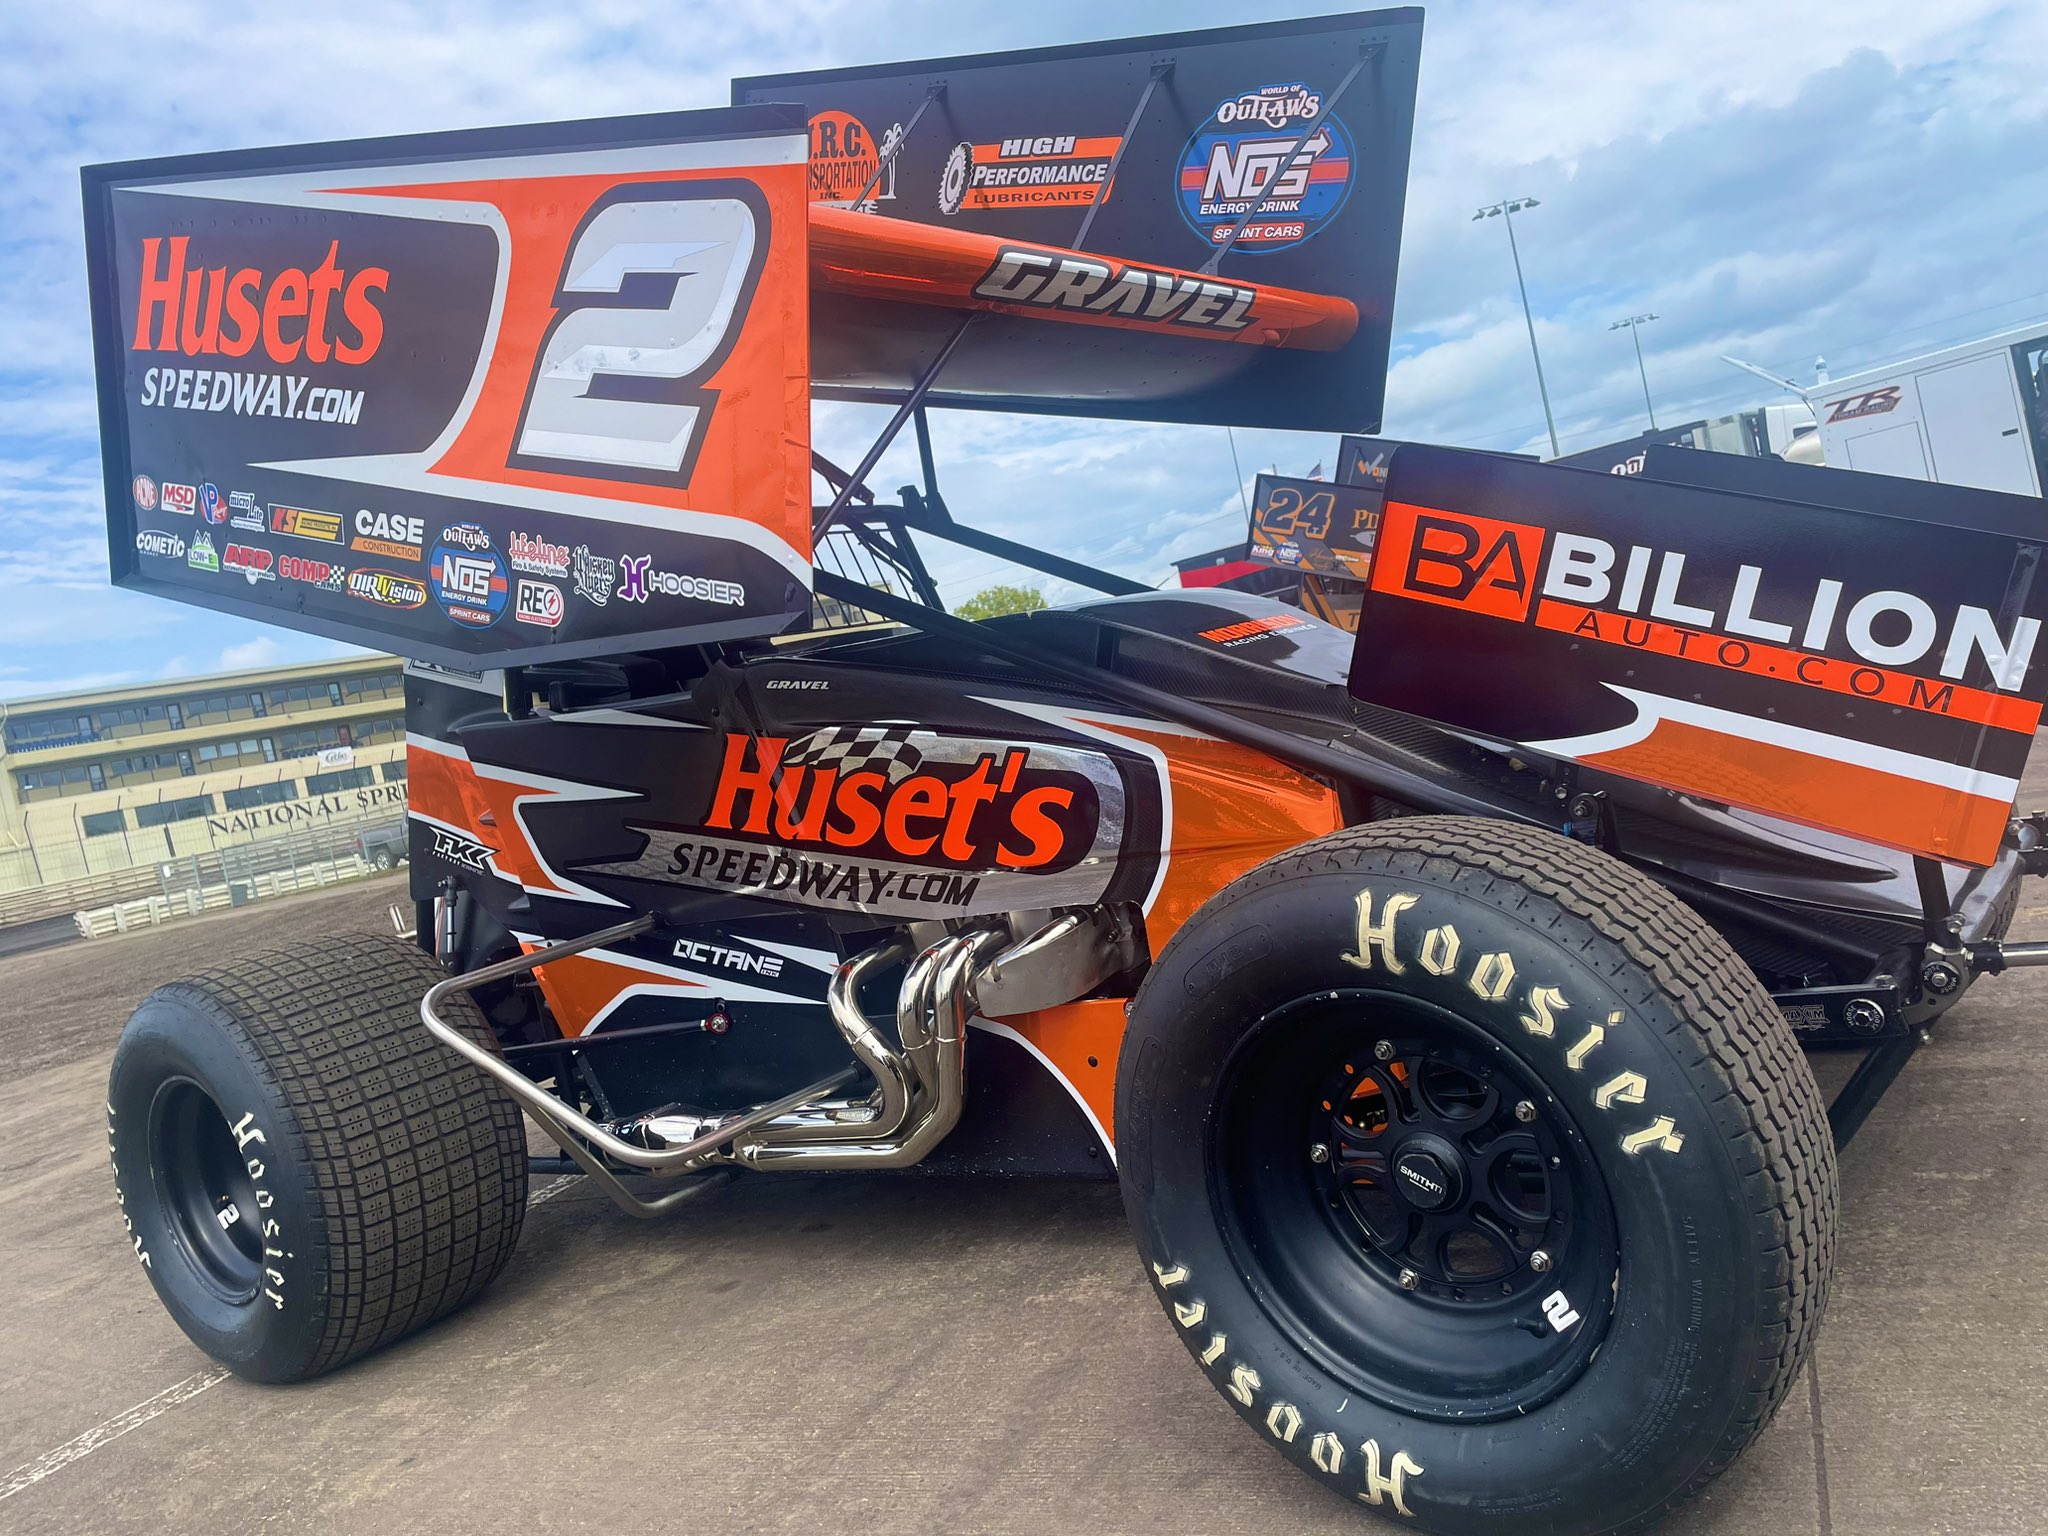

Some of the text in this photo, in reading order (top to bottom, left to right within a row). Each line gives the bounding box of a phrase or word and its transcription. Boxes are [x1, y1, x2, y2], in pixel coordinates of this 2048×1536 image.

[1260, 84, 1302, 95] WORLD OF
[1001, 136, 1076, 157] HIGH
[972, 163, 1108, 187] PERFORMANCE
[1203, 133, 1332, 199] NOS
[820, 192, 843, 200] INC.
[973, 190, 1095, 204] LUBRICANTS
[1214, 226, 1302, 239] SPINT CARS
[132, 236, 390, 365] Husets
[975, 250, 1257, 329] GRAVEL
[508, 180, 769, 486] 2
[141, 367, 365, 425] SPEEDWAY.COM
[163, 484, 195, 505] MSD
[199, 483, 219, 524] VP
[355, 509, 425, 544] CASE
[1262, 488, 1335, 539] 24
[136, 531, 185, 557] COMETIC
[223, 543, 273, 573] ARP
[362, 540, 420, 558] CONSTRUCTION
[1403, 514, 1527, 604] BA
[279, 555, 331, 583] COMP
[314, 579, 342, 592] CAMS
[442, 554, 497, 596] NOS
[441, 591, 488, 606] ENERGY DRINK
[650, 574, 745, 607] HOOSIER
[449, 608, 491, 622] SPRINT CARS
[1543, 532, 2042, 693] BILLION
[1223, 623, 1317, 648] RACING ENGINES
[1574, 611, 1954, 713] AUTO.COM
[766, 680, 830, 690] GRAVEL
[210, 796, 348, 837] NATIONAL
[704, 732, 1074, 867] Huset's
[668, 843, 980, 906] SPEEDWAY.COM
[673, 939, 784, 974] OCTANE
[1339, 887, 1686, 1156] Hoosier
[216, 1203, 240, 1230] 2
[228, 1112, 294, 1310] Hoosier
[1540, 1290, 1580, 1334] 2
[1152, 1260, 1425, 1518] Hoosier
